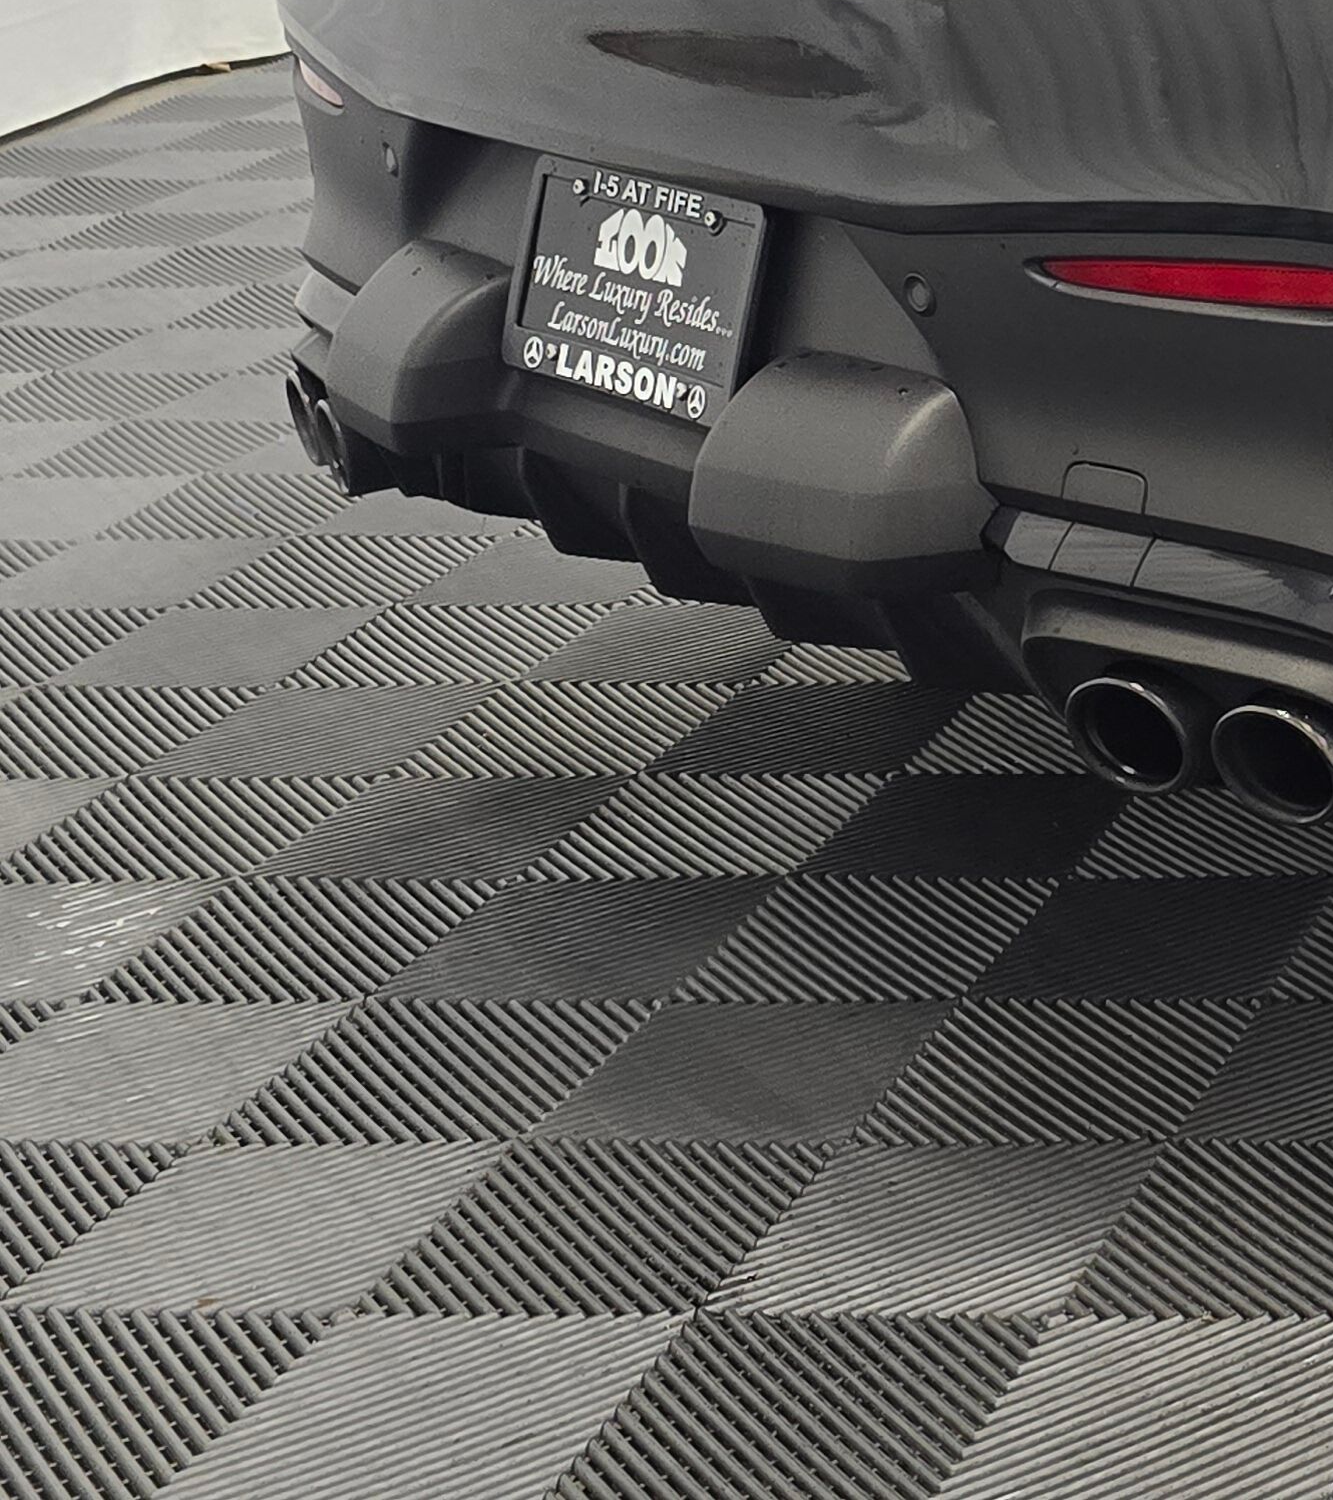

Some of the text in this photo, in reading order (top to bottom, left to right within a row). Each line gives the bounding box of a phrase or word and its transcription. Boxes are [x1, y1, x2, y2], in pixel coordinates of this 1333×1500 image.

[593, 171, 703, 219] I-5 AT FIFE
[533, 254, 733, 338] Where Luxury Resides...
[547, 300, 706, 371] LarsonLuxury.com
[555, 343, 678, 409] LARSON
